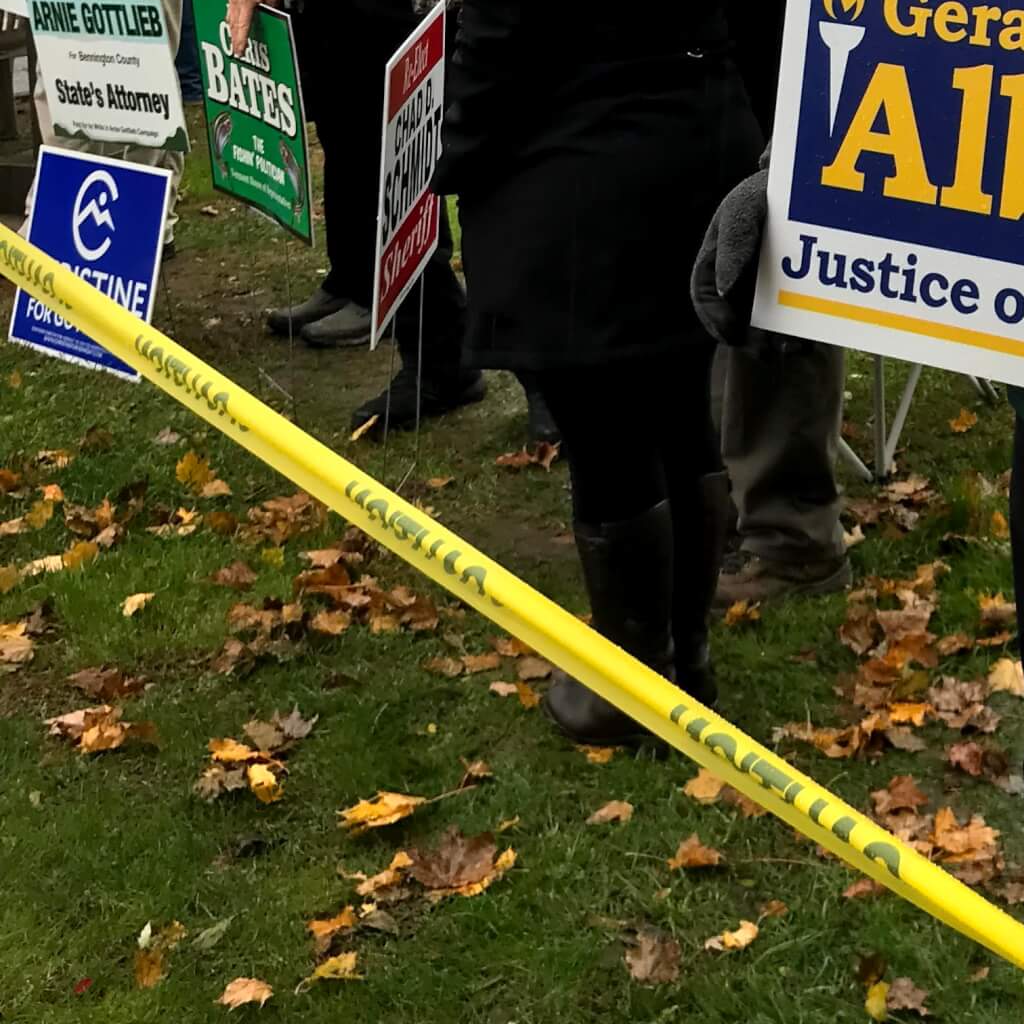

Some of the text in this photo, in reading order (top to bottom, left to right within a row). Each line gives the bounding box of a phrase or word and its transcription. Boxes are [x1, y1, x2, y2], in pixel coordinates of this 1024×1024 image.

[32, 0, 163, 38] ARNIE GOTTLIEB
[219, 21, 270, 73] CRIS
[78, 50, 115, 67] Bennington
[116, 53, 140, 68] County
[201, 40, 297, 138] BATES
[55, 78, 170, 120] State's Attorney
[394, 88, 423, 156] CHAD
[382, 103, 442, 248] SCHMIDT
[380, 192, 435, 304] Sheriff
[781, 233, 981, 315] Justice
